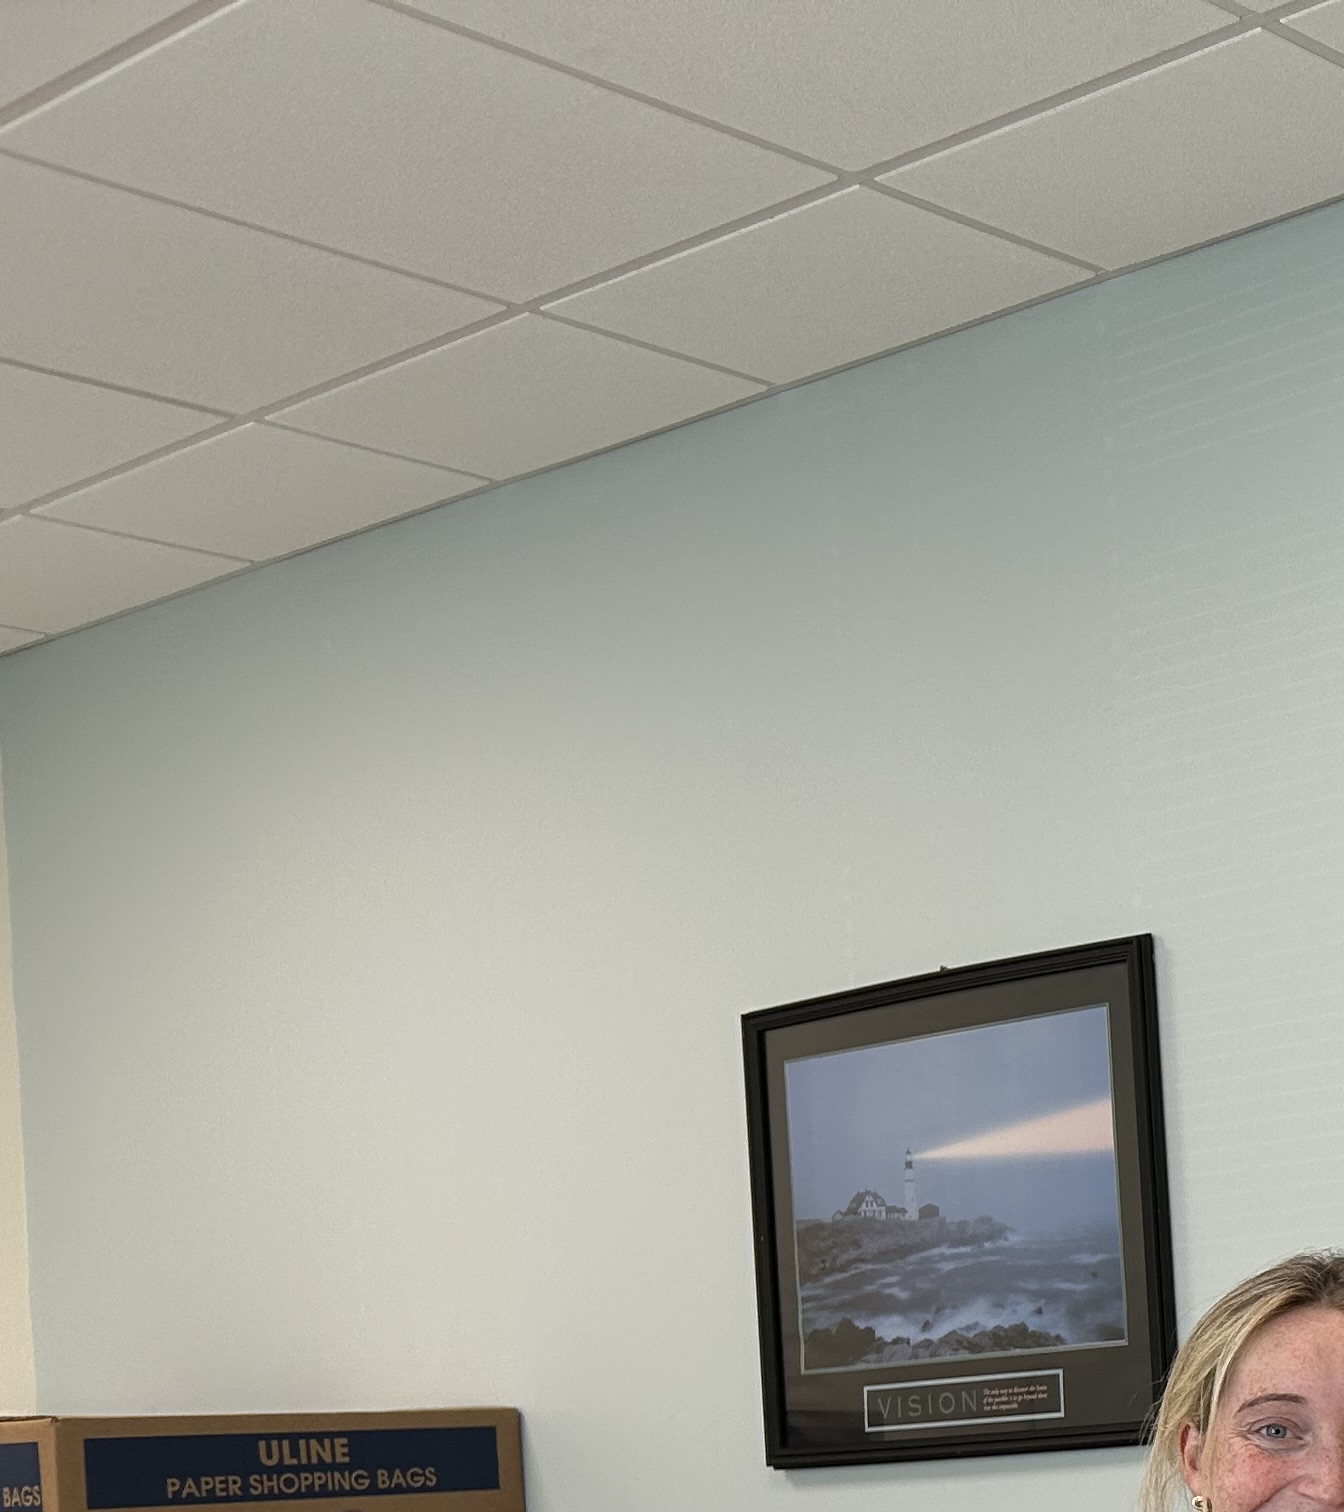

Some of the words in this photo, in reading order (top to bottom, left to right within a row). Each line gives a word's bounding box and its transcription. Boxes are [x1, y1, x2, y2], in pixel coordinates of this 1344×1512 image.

[877, 1389, 978, 1419] VISION
[258, 1437, 351, 1466] ULINE
[3, 1484, 41, 1508] BAGS
[166, 1475, 243, 1499] PAPER
[250, 1469, 371, 1496] SHOPPING
[377, 1466, 437, 1490] BAGS
